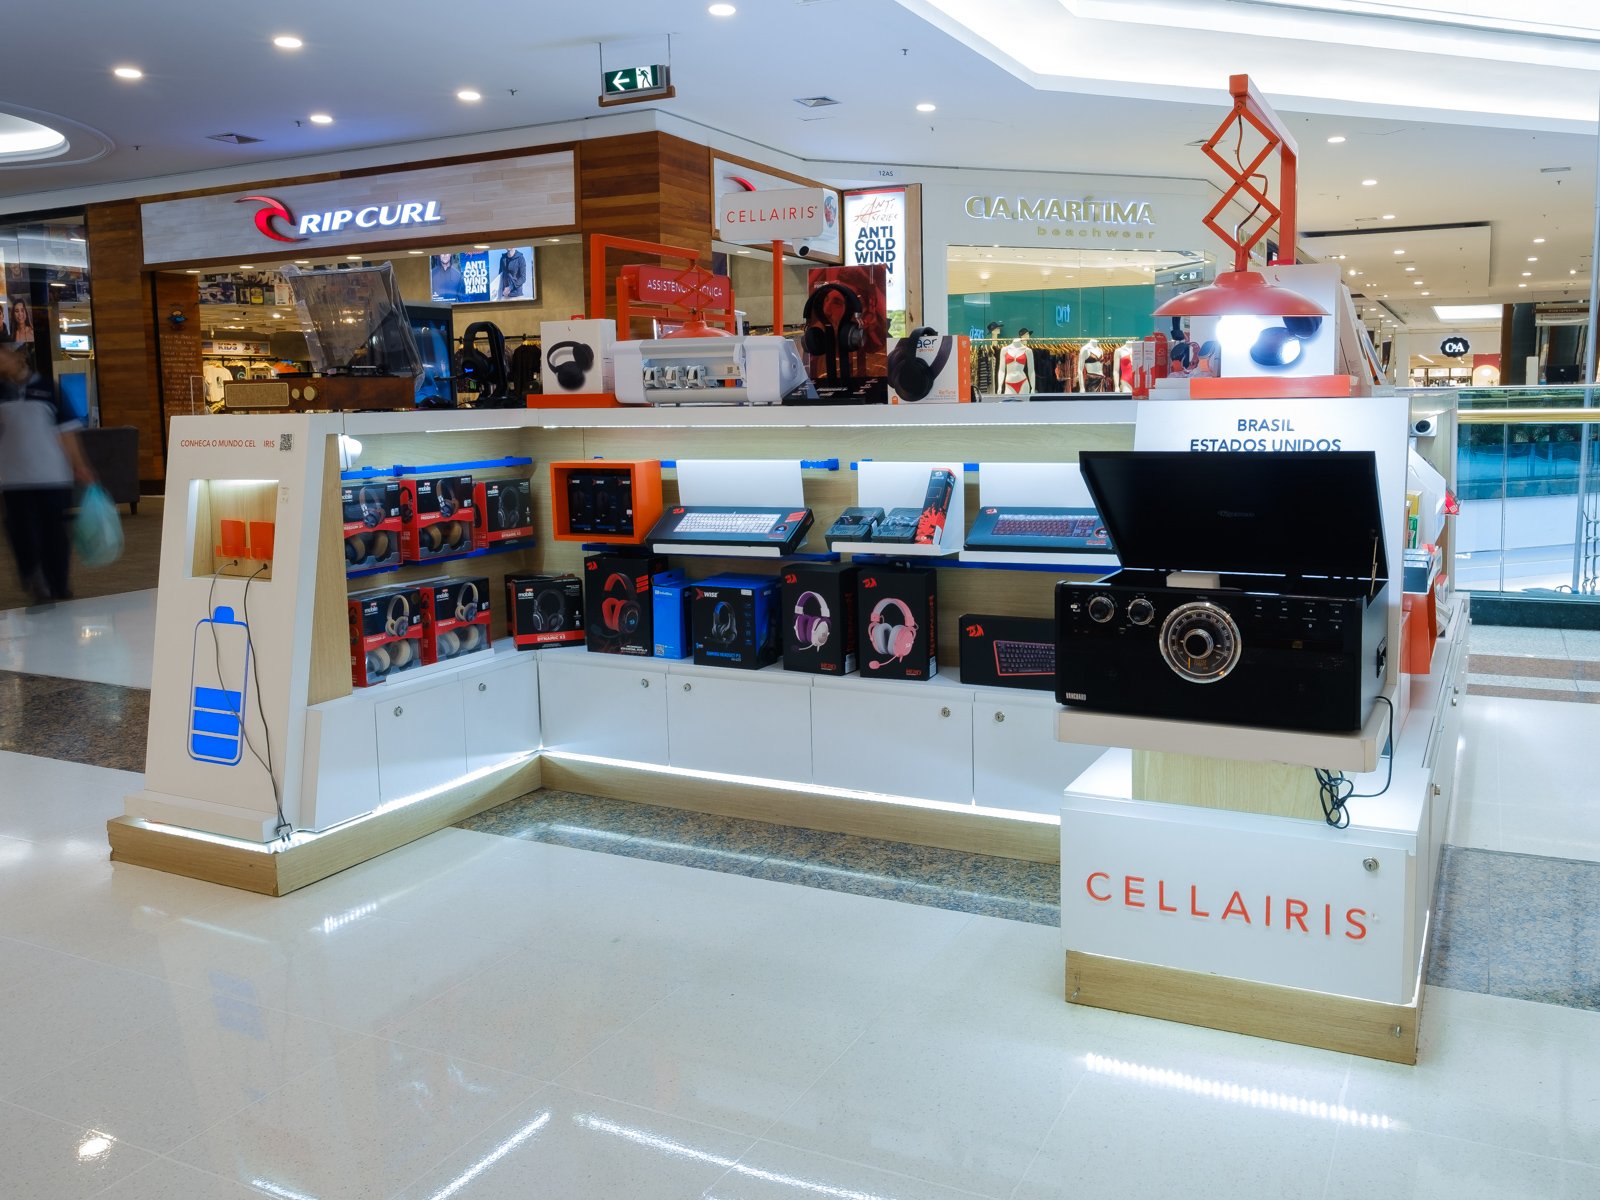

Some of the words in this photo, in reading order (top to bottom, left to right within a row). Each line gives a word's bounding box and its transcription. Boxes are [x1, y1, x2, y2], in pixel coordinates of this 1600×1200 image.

[299, 209, 353, 235] RIP
[354, 200, 442, 229] CURL
[726, 205, 815, 224] CELLAIRIS
[857, 225, 894, 239] ANTI
[1037, 226, 1155, 240] beachwear
[854, 238, 897, 252] COLD
[854, 251, 897, 264] WIND
[465, 260, 486, 271] ANTI
[463, 269, 488, 278] COLD
[463, 277, 488, 286] WIND
[465, 284, 487, 295] RAIN
[1445, 341, 1465, 353] C&A
[1237, 418, 1295, 432] BRASIL
[211, 439, 217, 448] O
[218, 439, 243, 448] MUNDO
[1190, 438, 1267, 452] ESTADOS
[1271, 438, 1342, 452] UNIDOS
[1086, 871, 1368, 941] CELLAIRIS
